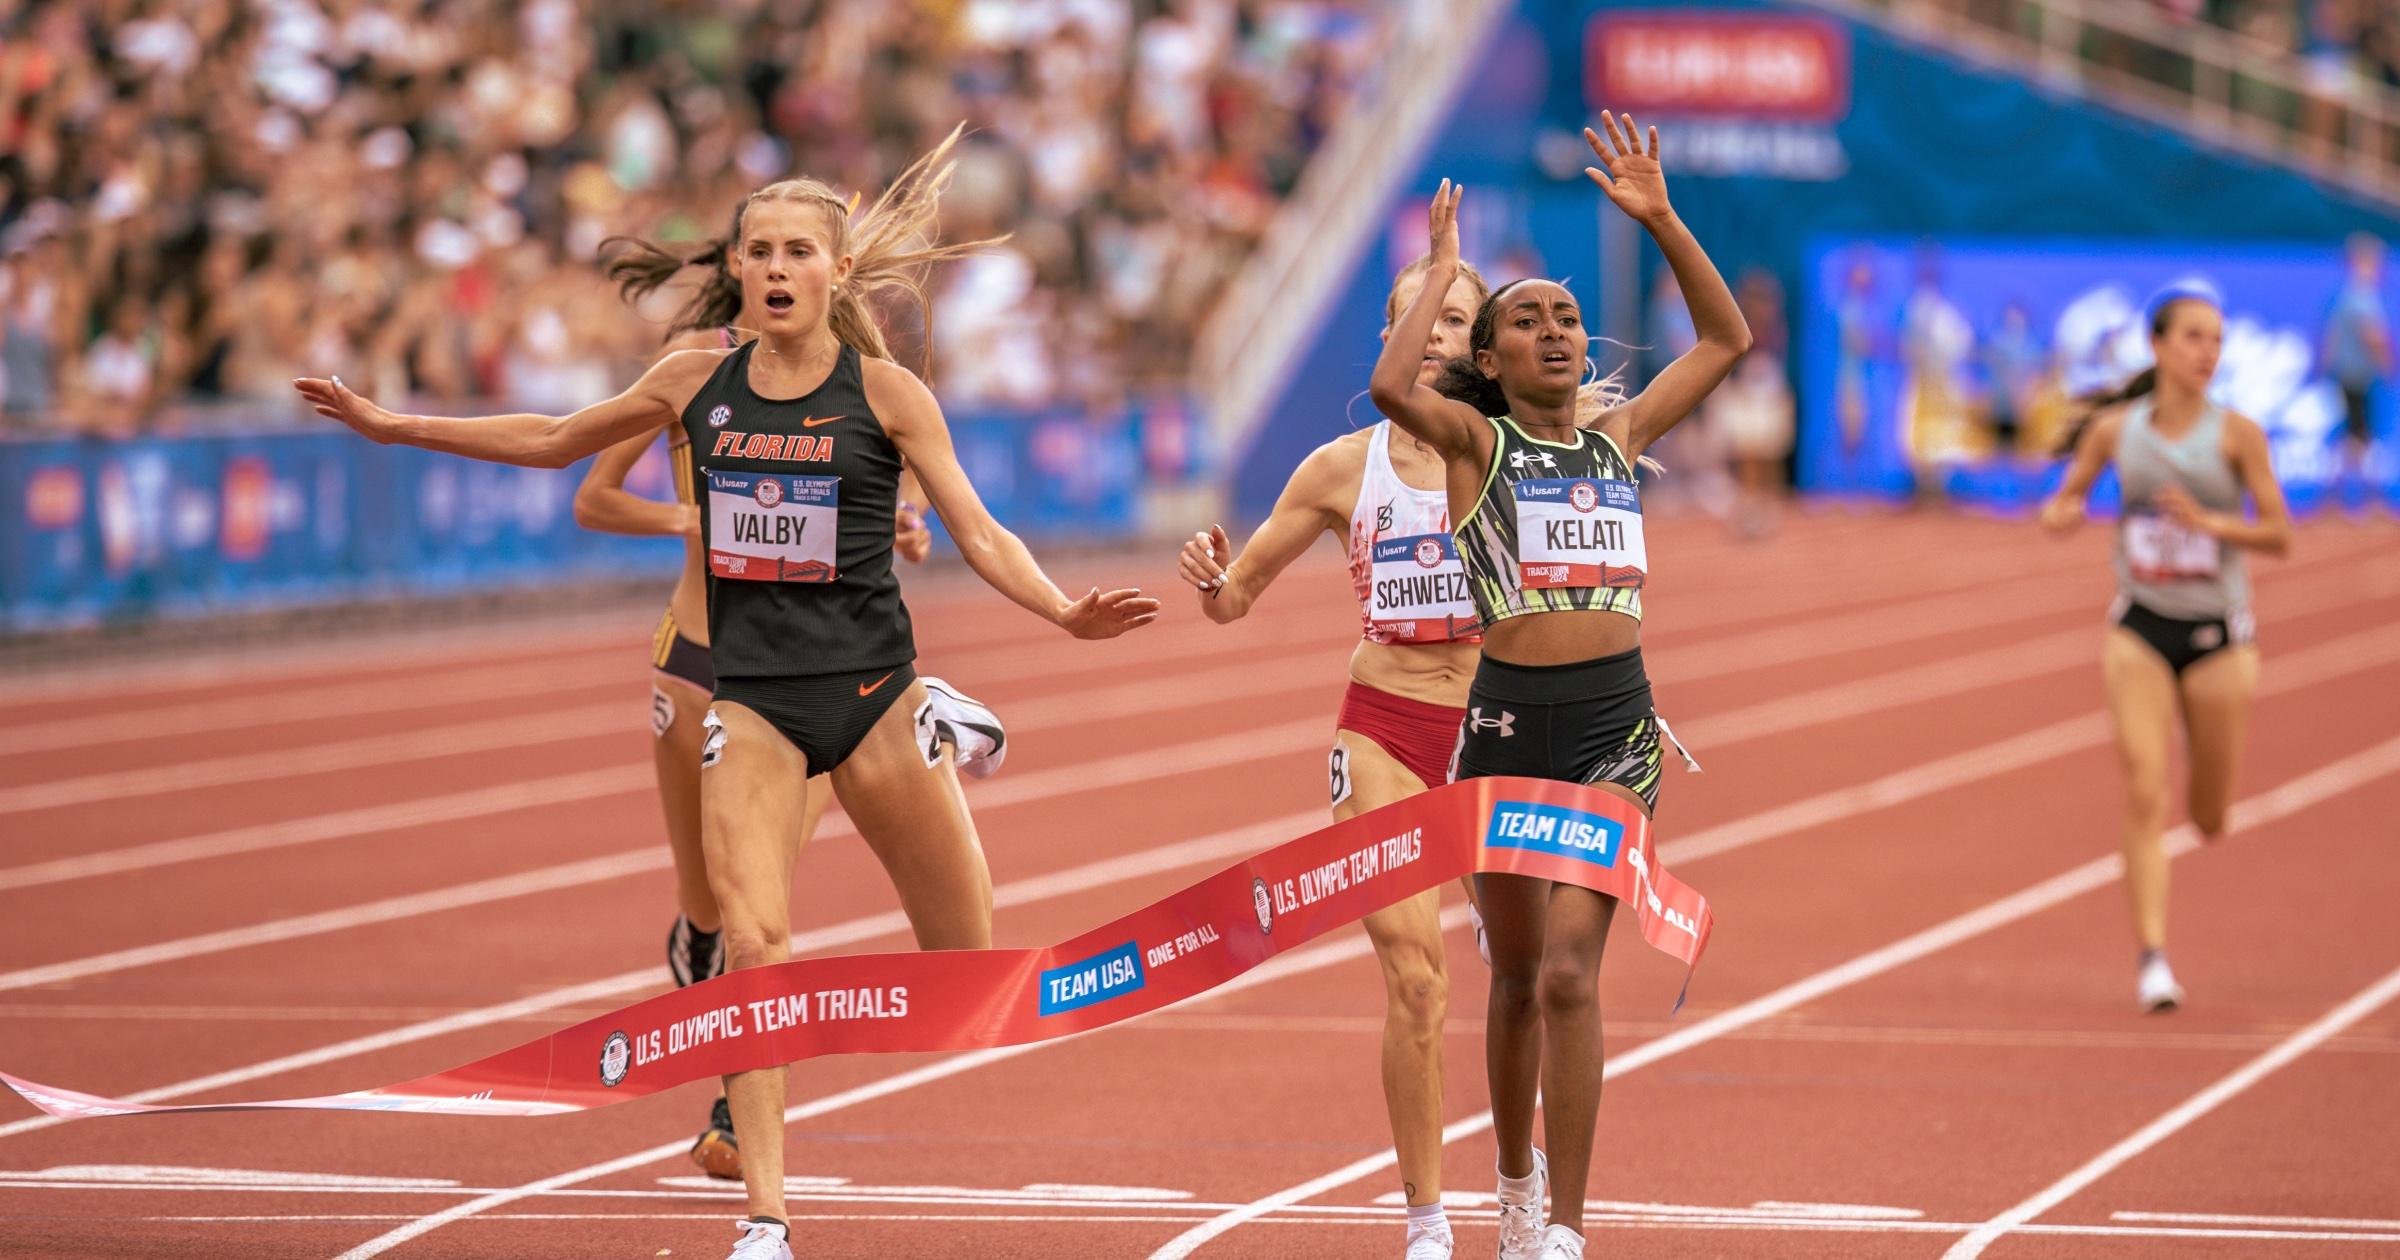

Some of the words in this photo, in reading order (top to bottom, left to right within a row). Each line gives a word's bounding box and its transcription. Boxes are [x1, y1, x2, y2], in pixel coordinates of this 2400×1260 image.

[711, 431, 834, 462] FLORIDA
[725, 481, 748, 489] USATF
[1535, 487, 1562, 495] USATF
[733, 512, 807, 546] VALBY
[1545, 519, 1625, 551] KELATI
[1385, 546, 1407, 556] USATF
[1526, 565, 1569, 577] TRACKTOWN
[1549, 574, 1568, 583] 2024
[1376, 572, 1470, 610] SCHWEIZ
[1331, 748, 1345, 803] 8
[1498, 812, 1557, 842] TEAM
[1557, 820, 1609, 855] USA
[1273, 878, 1300, 915] U.S.
[1300, 857, 1349, 906] OLYMPIC
[1349, 843, 1380, 886] TEAM
[1381, 827, 1422, 872] TRIALS
[1663, 907, 1698, 939] ALL
[1147, 941, 1177, 969] ONE
[1175, 931, 1201, 956] FOR
[1199, 923, 1220, 947] ALL
[1050, 967, 1098, 1004] TEAM
[1101, 955, 1136, 990] USA
[635, 1029, 664, 1066] U.S.
[668, 1005, 743, 1055] OLYMPIC
[747, 993, 808, 1034] TEAM
[815, 986, 908, 1021] TRIALS
